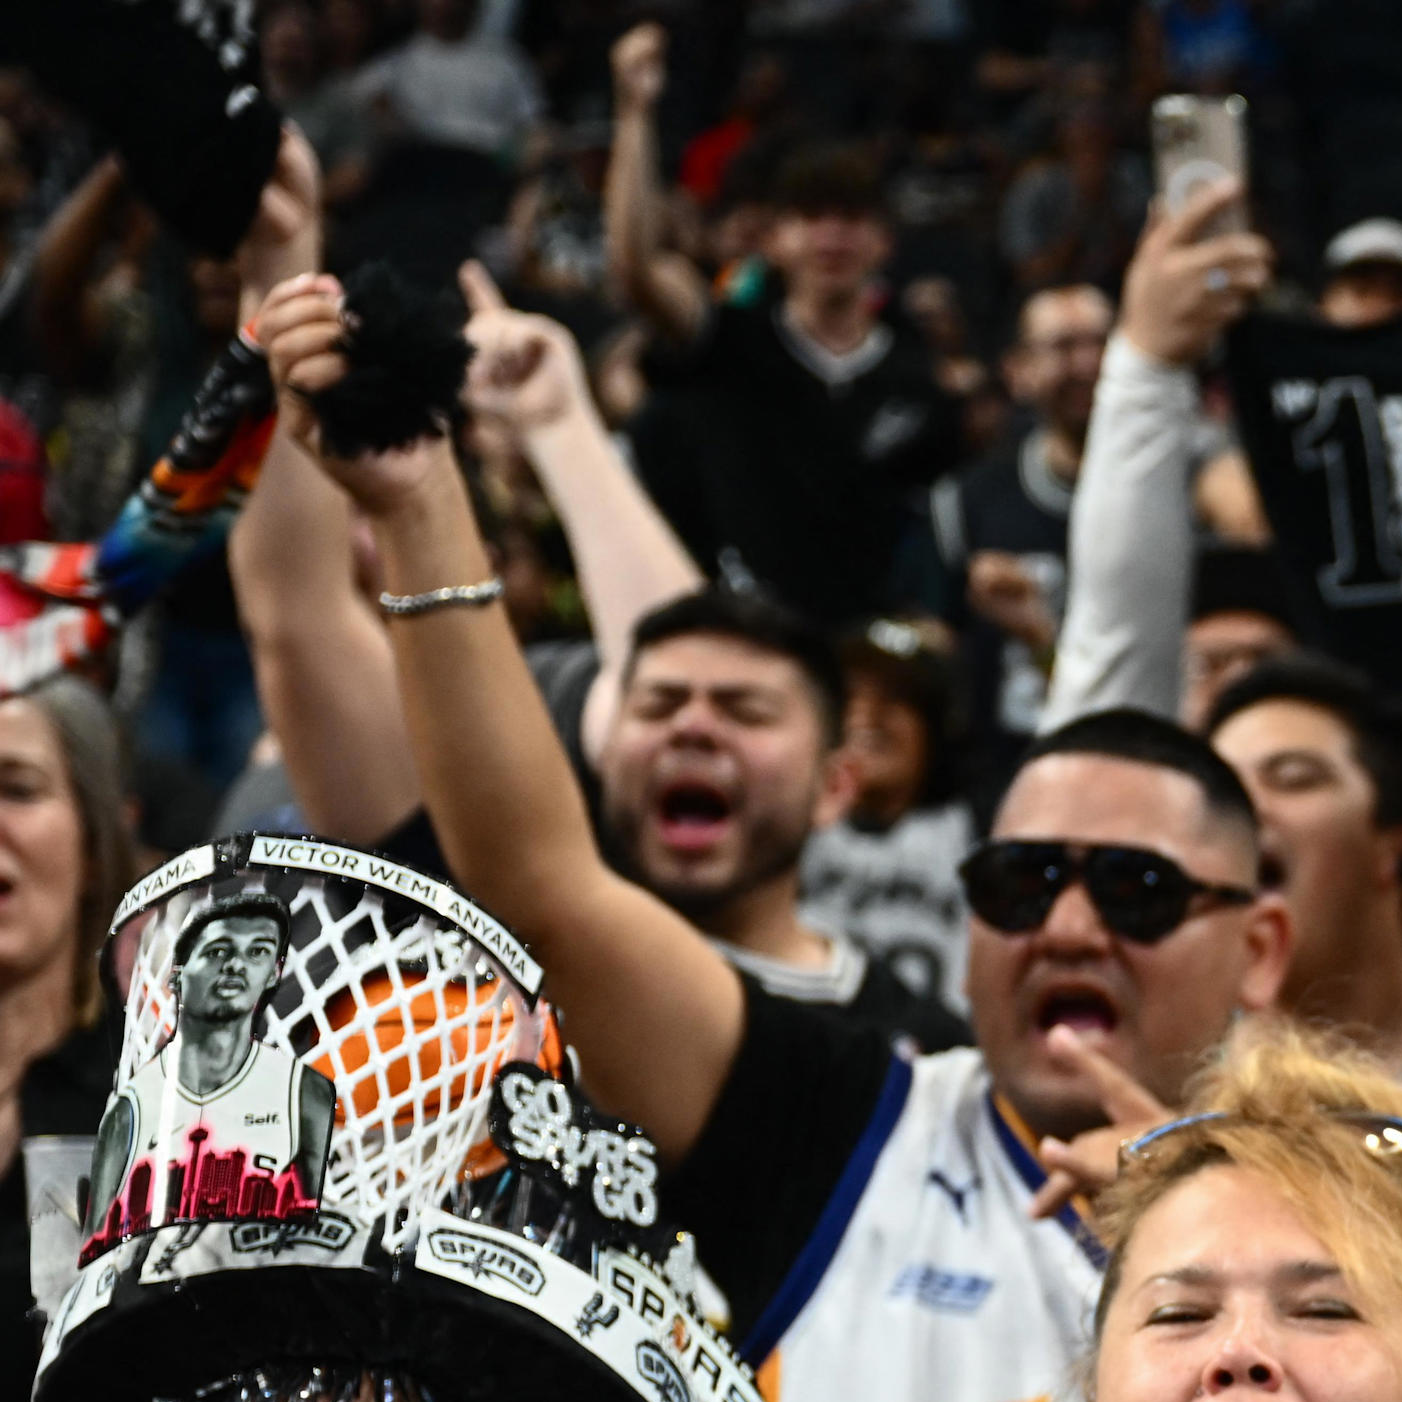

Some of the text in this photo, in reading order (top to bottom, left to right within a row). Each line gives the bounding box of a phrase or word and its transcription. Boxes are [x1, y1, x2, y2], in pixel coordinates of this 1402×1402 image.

[263, 842, 359, 873] VICTOR
[502, 1072, 571, 1122] GO
[511, 1114, 658, 1185] SPURS
[594, 1165, 657, 1227] GO
